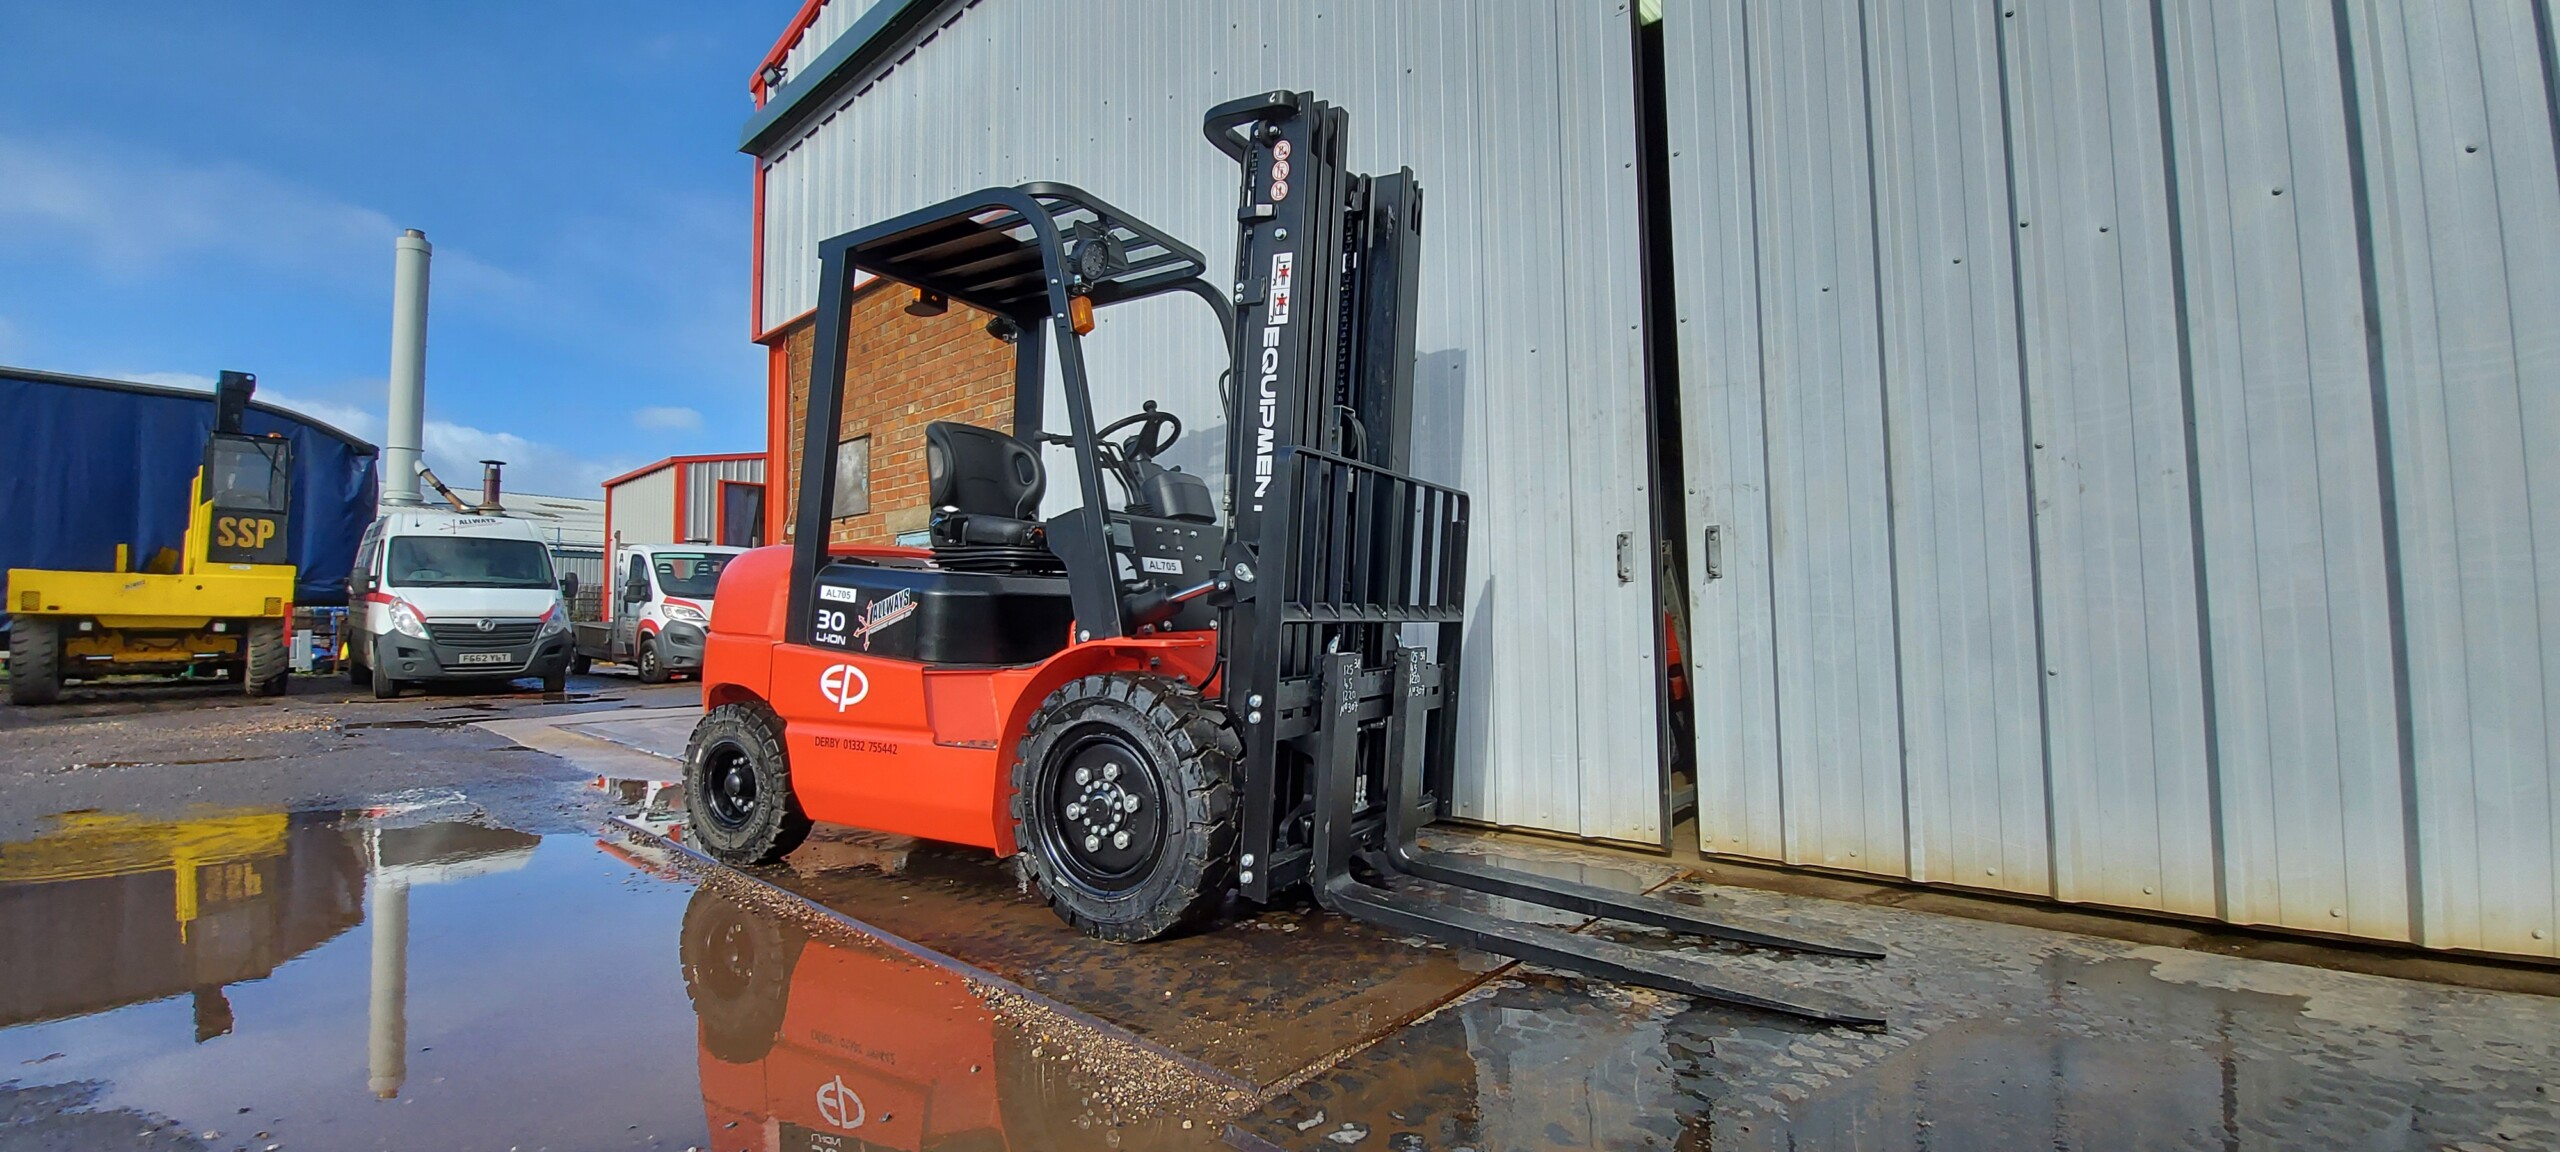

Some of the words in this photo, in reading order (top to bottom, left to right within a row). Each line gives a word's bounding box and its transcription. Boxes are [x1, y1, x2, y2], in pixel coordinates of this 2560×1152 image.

[1253, 326, 1280, 512] EQUIPMEN
[217, 516, 275, 549] SSP
[1149, 560, 1177, 571] AL705
[825, 588, 851, 600] AL705
[872, 588, 910, 622] ALLWAYS
[817, 608, 846, 632] 30
[820, 663, 869, 713] EP
[1343, 691, 1356, 702] 1220
[815, 736, 840, 748] DERBY
[843, 739, 865, 752] 01332
[868, 741, 898, 755] 755442
